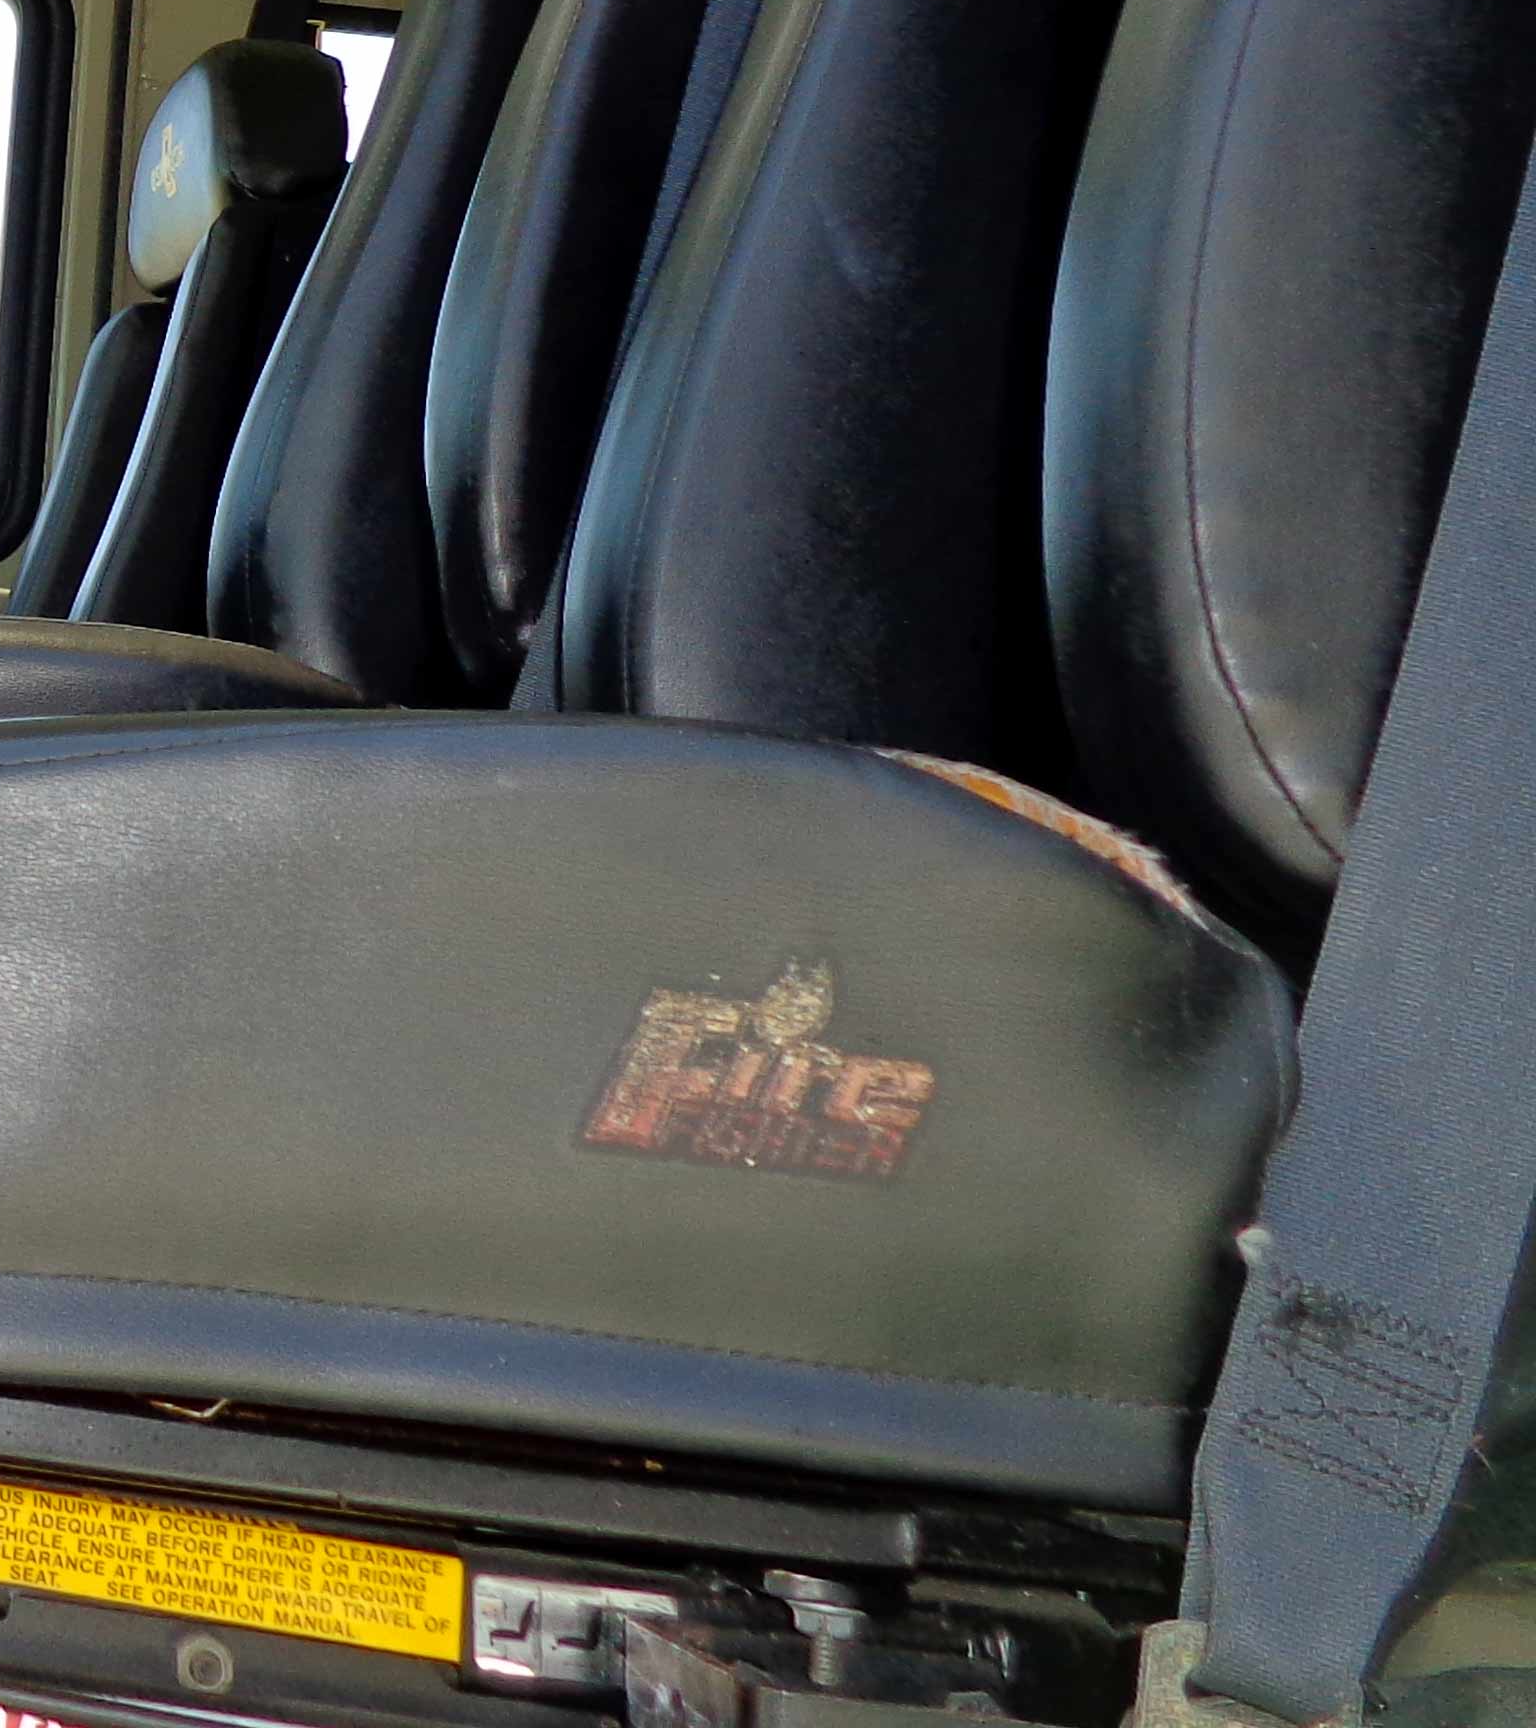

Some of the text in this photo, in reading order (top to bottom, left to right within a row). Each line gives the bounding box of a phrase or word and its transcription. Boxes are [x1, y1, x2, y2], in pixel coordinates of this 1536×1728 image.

[33, 1493, 103, 1519] INJURY
[111, 1506, 150, 1526] MAY
[158, 1514, 228, 1540] OCCUR
[236, 1527, 254, 1543] IF
[261, 1531, 316, 1554] HEAD
[323, 1542, 444, 1577] CLEARANCE
[145, 1531, 224, 1558] BEFORE
[232, 1545, 313, 1573] DRIVING
[321, 1560, 350, 1579] OR
[359, 1567, 428, 1593] RIDING
[77, 1538, 156, 1566] ENSURE
[164, 1552, 214, 1574] THAT
[222, 1562, 285, 1587] THERE
[293, 1574, 312, 1591] IS
[321, 1580, 426, 1612] ADEQUATE
[106, 1580, 145, 1602] SEE
[151, 1588, 265, 1622] OPERATION
[114, 1563, 139, 1581] AT
[145, 1568, 239, 1598] MAXIMUM
[246, 1585, 333, 1614] UPWARD
[342, 1601, 417, 1630] TRAVEL
[424, 1615, 451, 1635] OF
